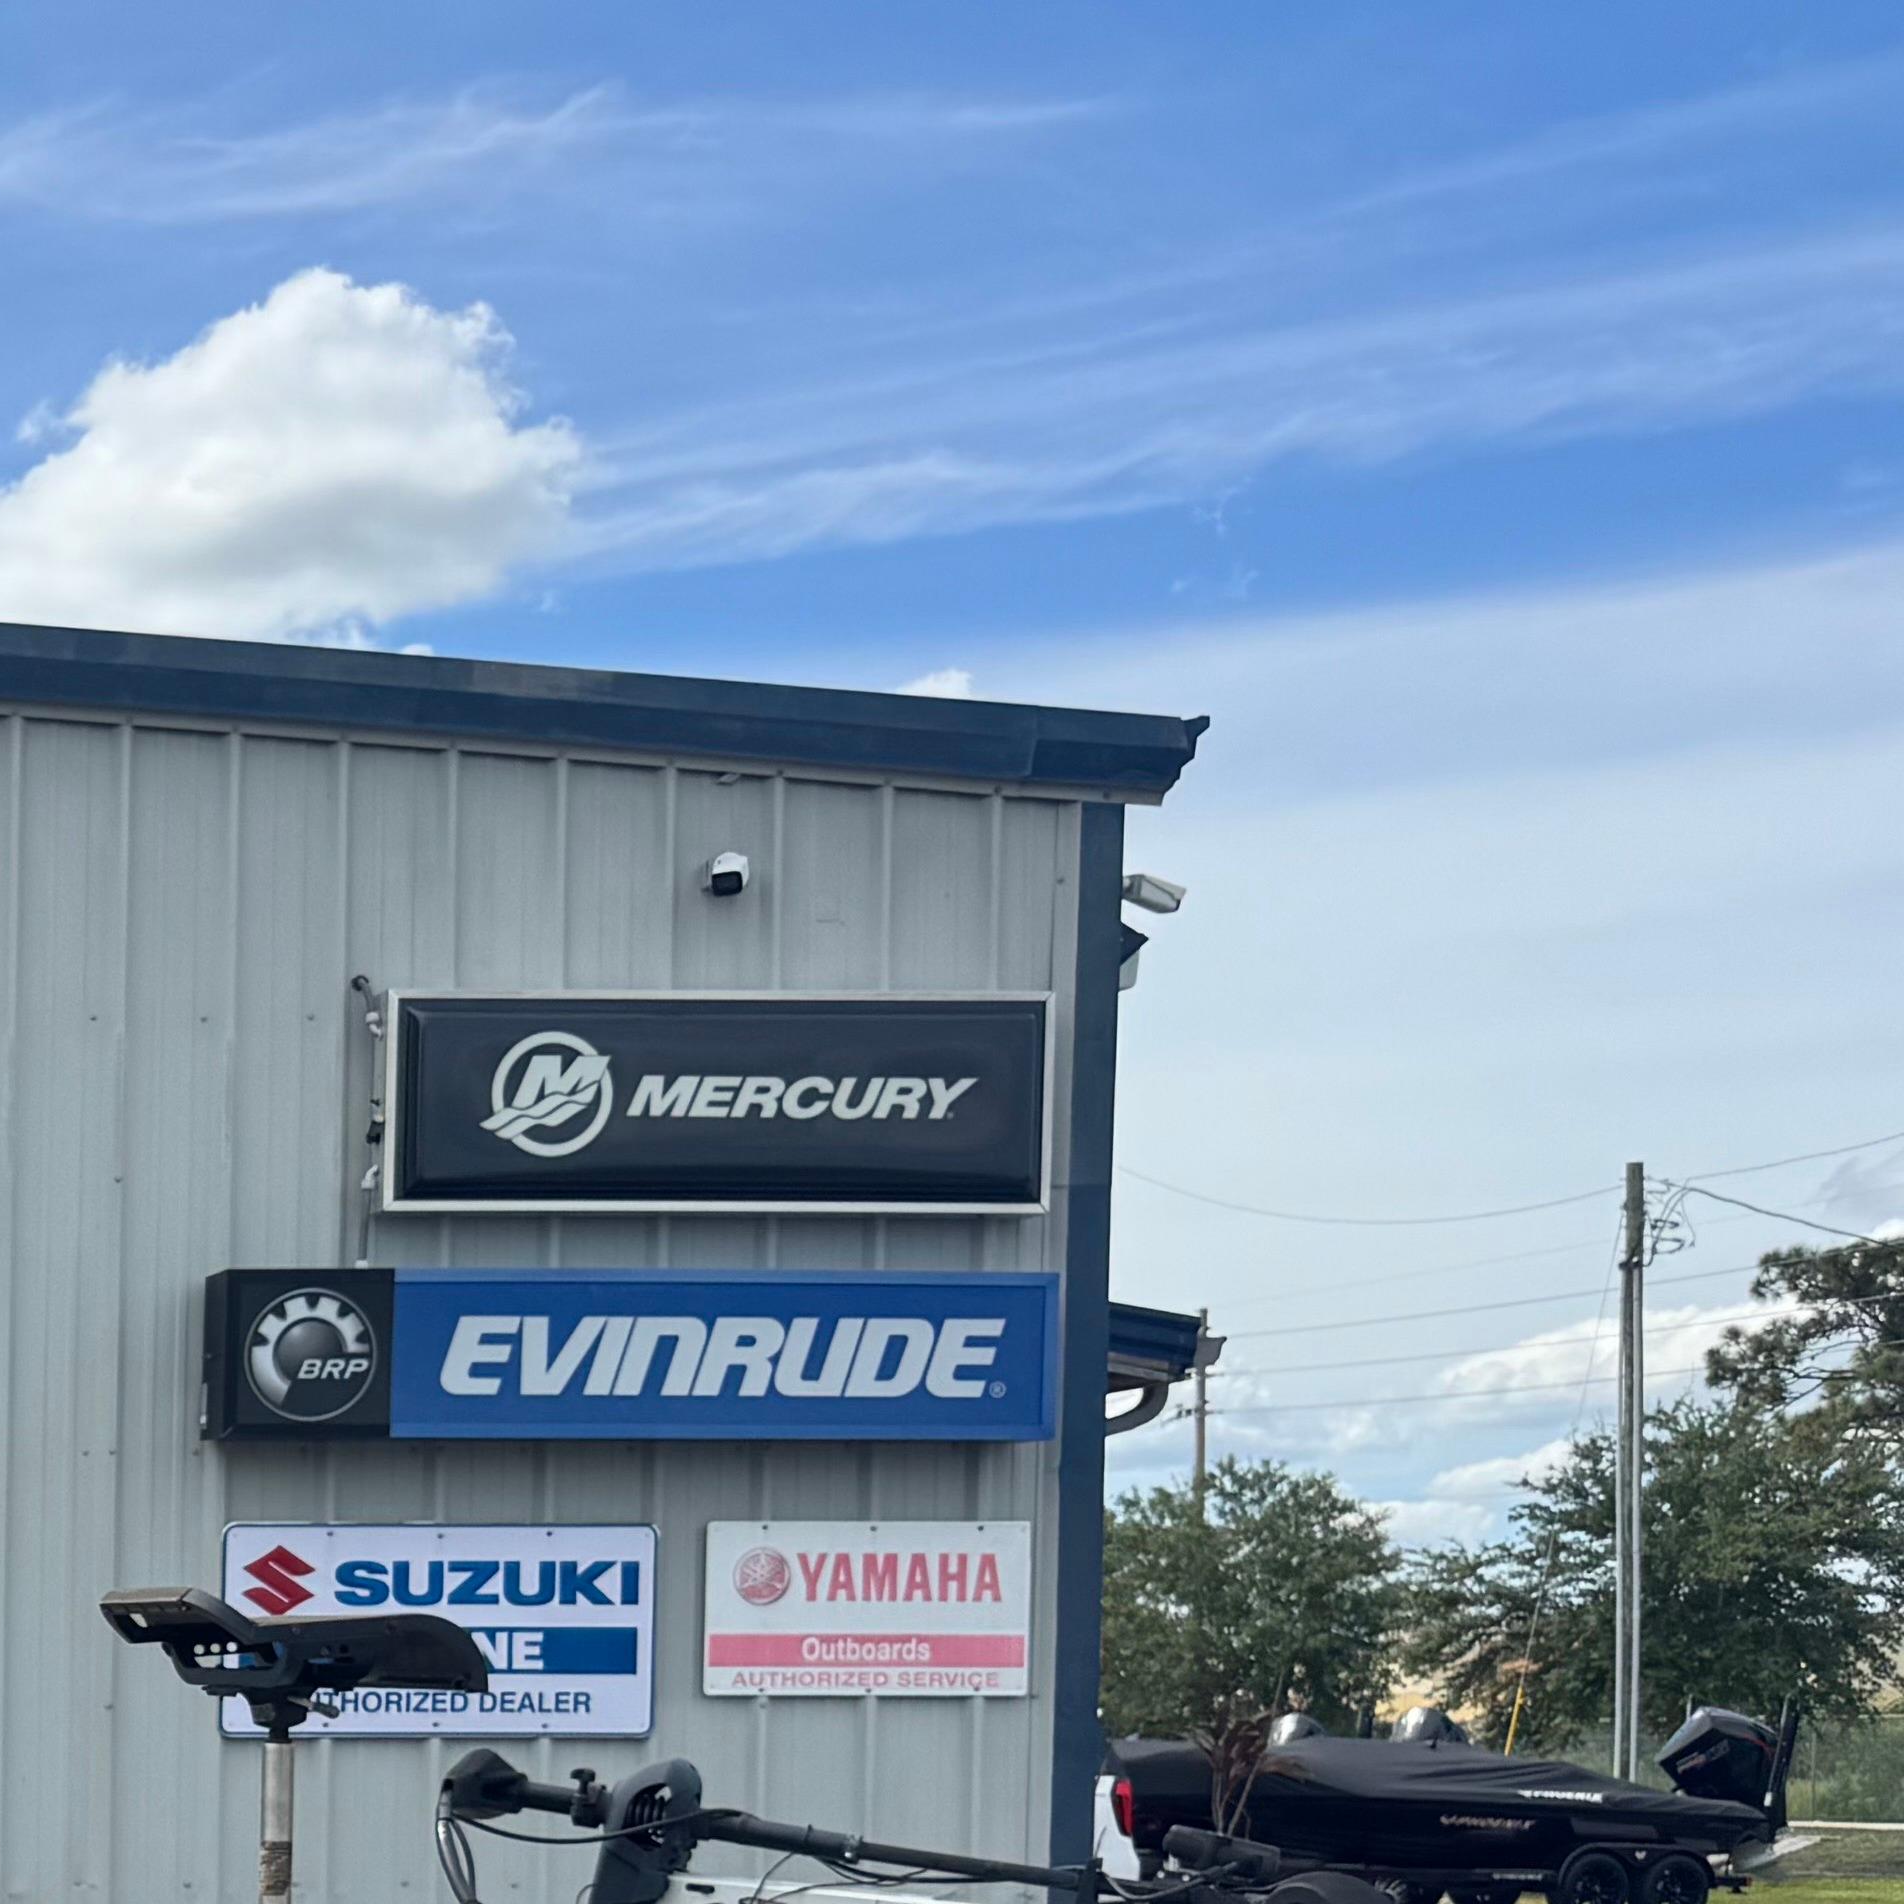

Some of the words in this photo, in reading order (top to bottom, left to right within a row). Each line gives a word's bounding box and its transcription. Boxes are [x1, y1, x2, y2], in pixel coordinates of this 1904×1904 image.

[626, 1074, 980, 1120] MERCURY
[296, 1358, 370, 1380] BRP
[439, 1315, 1008, 1399] EVINRUDE
[334, 1559, 640, 1607] SUZUKI
[795, 1552, 1003, 1603] YAMAHA
[800, 1636, 932, 1662] Outboards
[731, 1670, 889, 1688] AUTHORIZED
[895, 1671, 1000, 1689] SERVICE
[478, 1690, 591, 1714] DEALER
